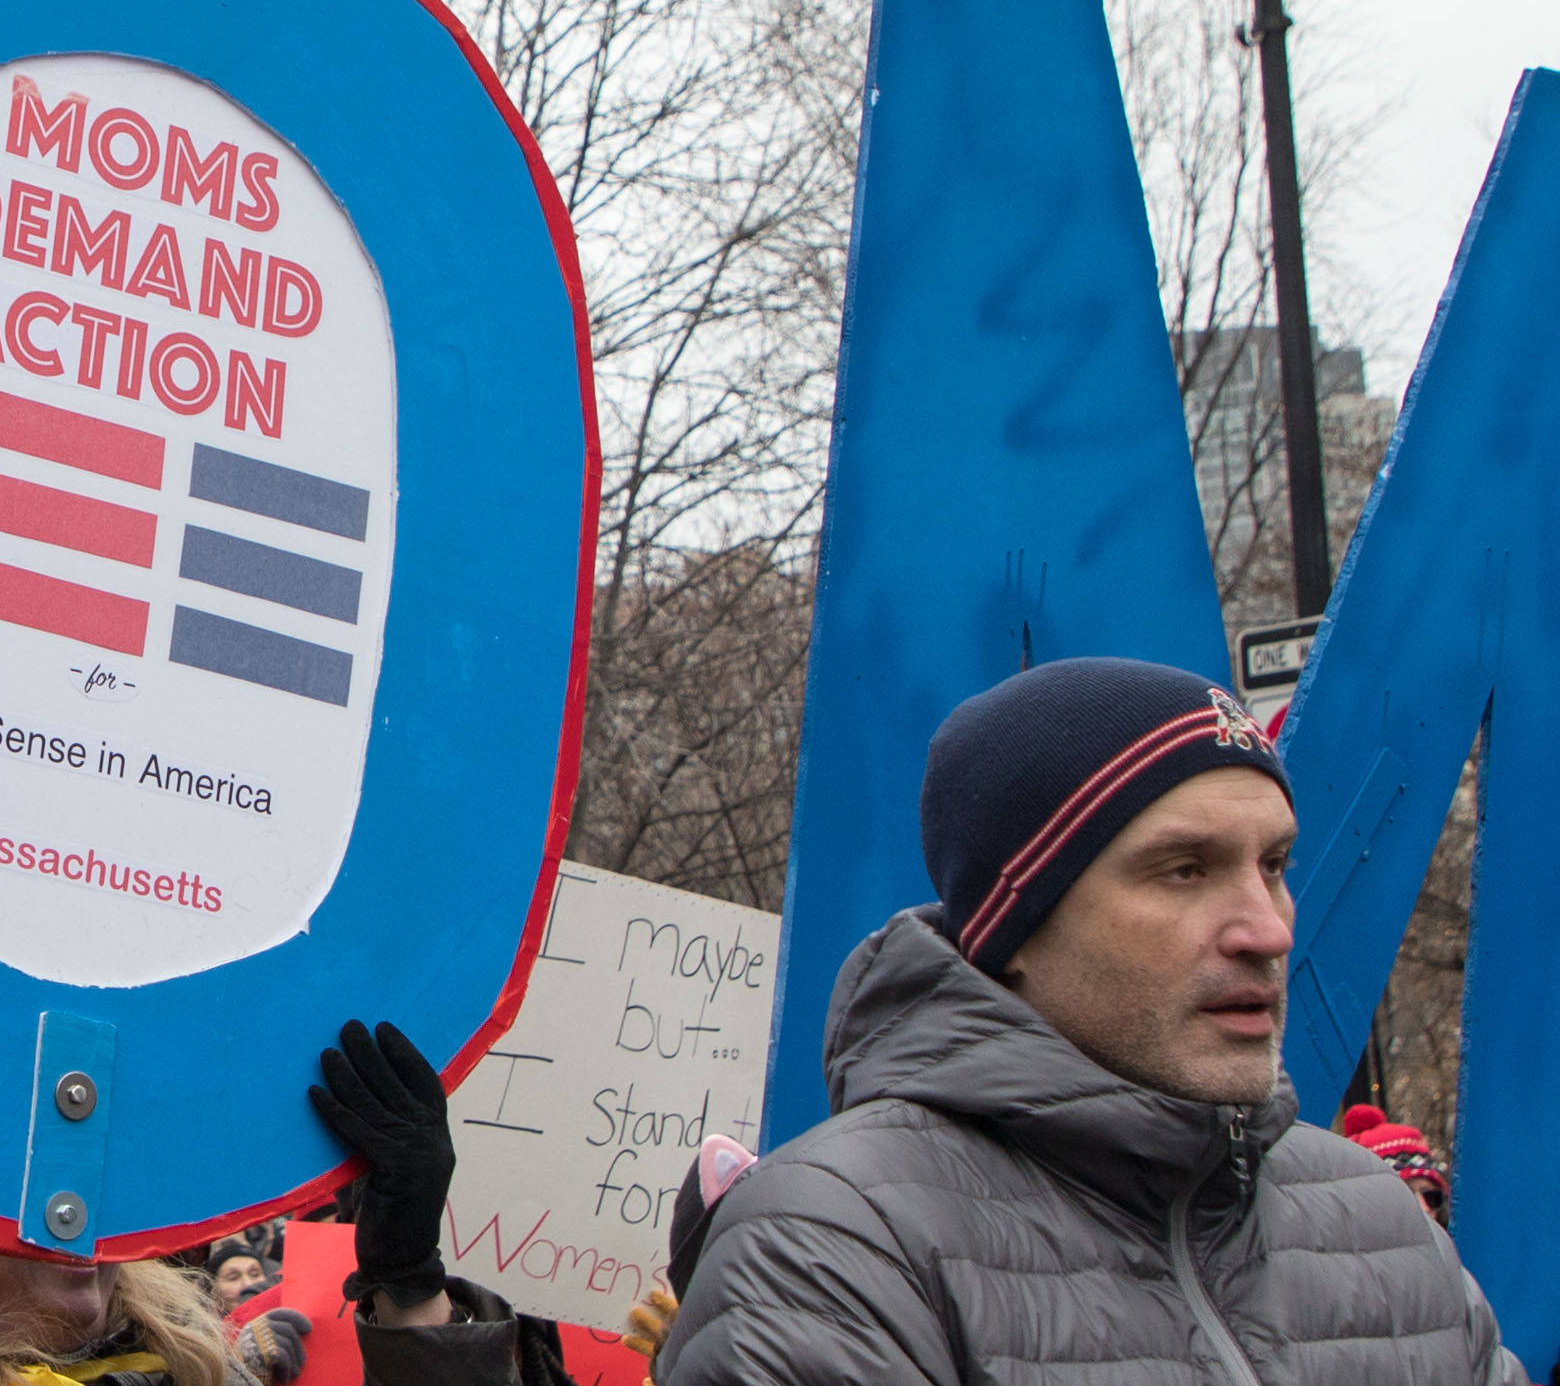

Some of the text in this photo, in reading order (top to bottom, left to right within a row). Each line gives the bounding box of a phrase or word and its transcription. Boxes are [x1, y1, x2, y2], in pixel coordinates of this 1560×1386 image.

[6, 76, 279, 232] MOMS
[1255, 645, 1287, 669] ONE
[97, 738, 125, 778] in
[137, 751, 273, 817] America
[539, 873, 597, 964] I
[463, 1050, 554, 1135] I
[595, 1150, 680, 1230] for
